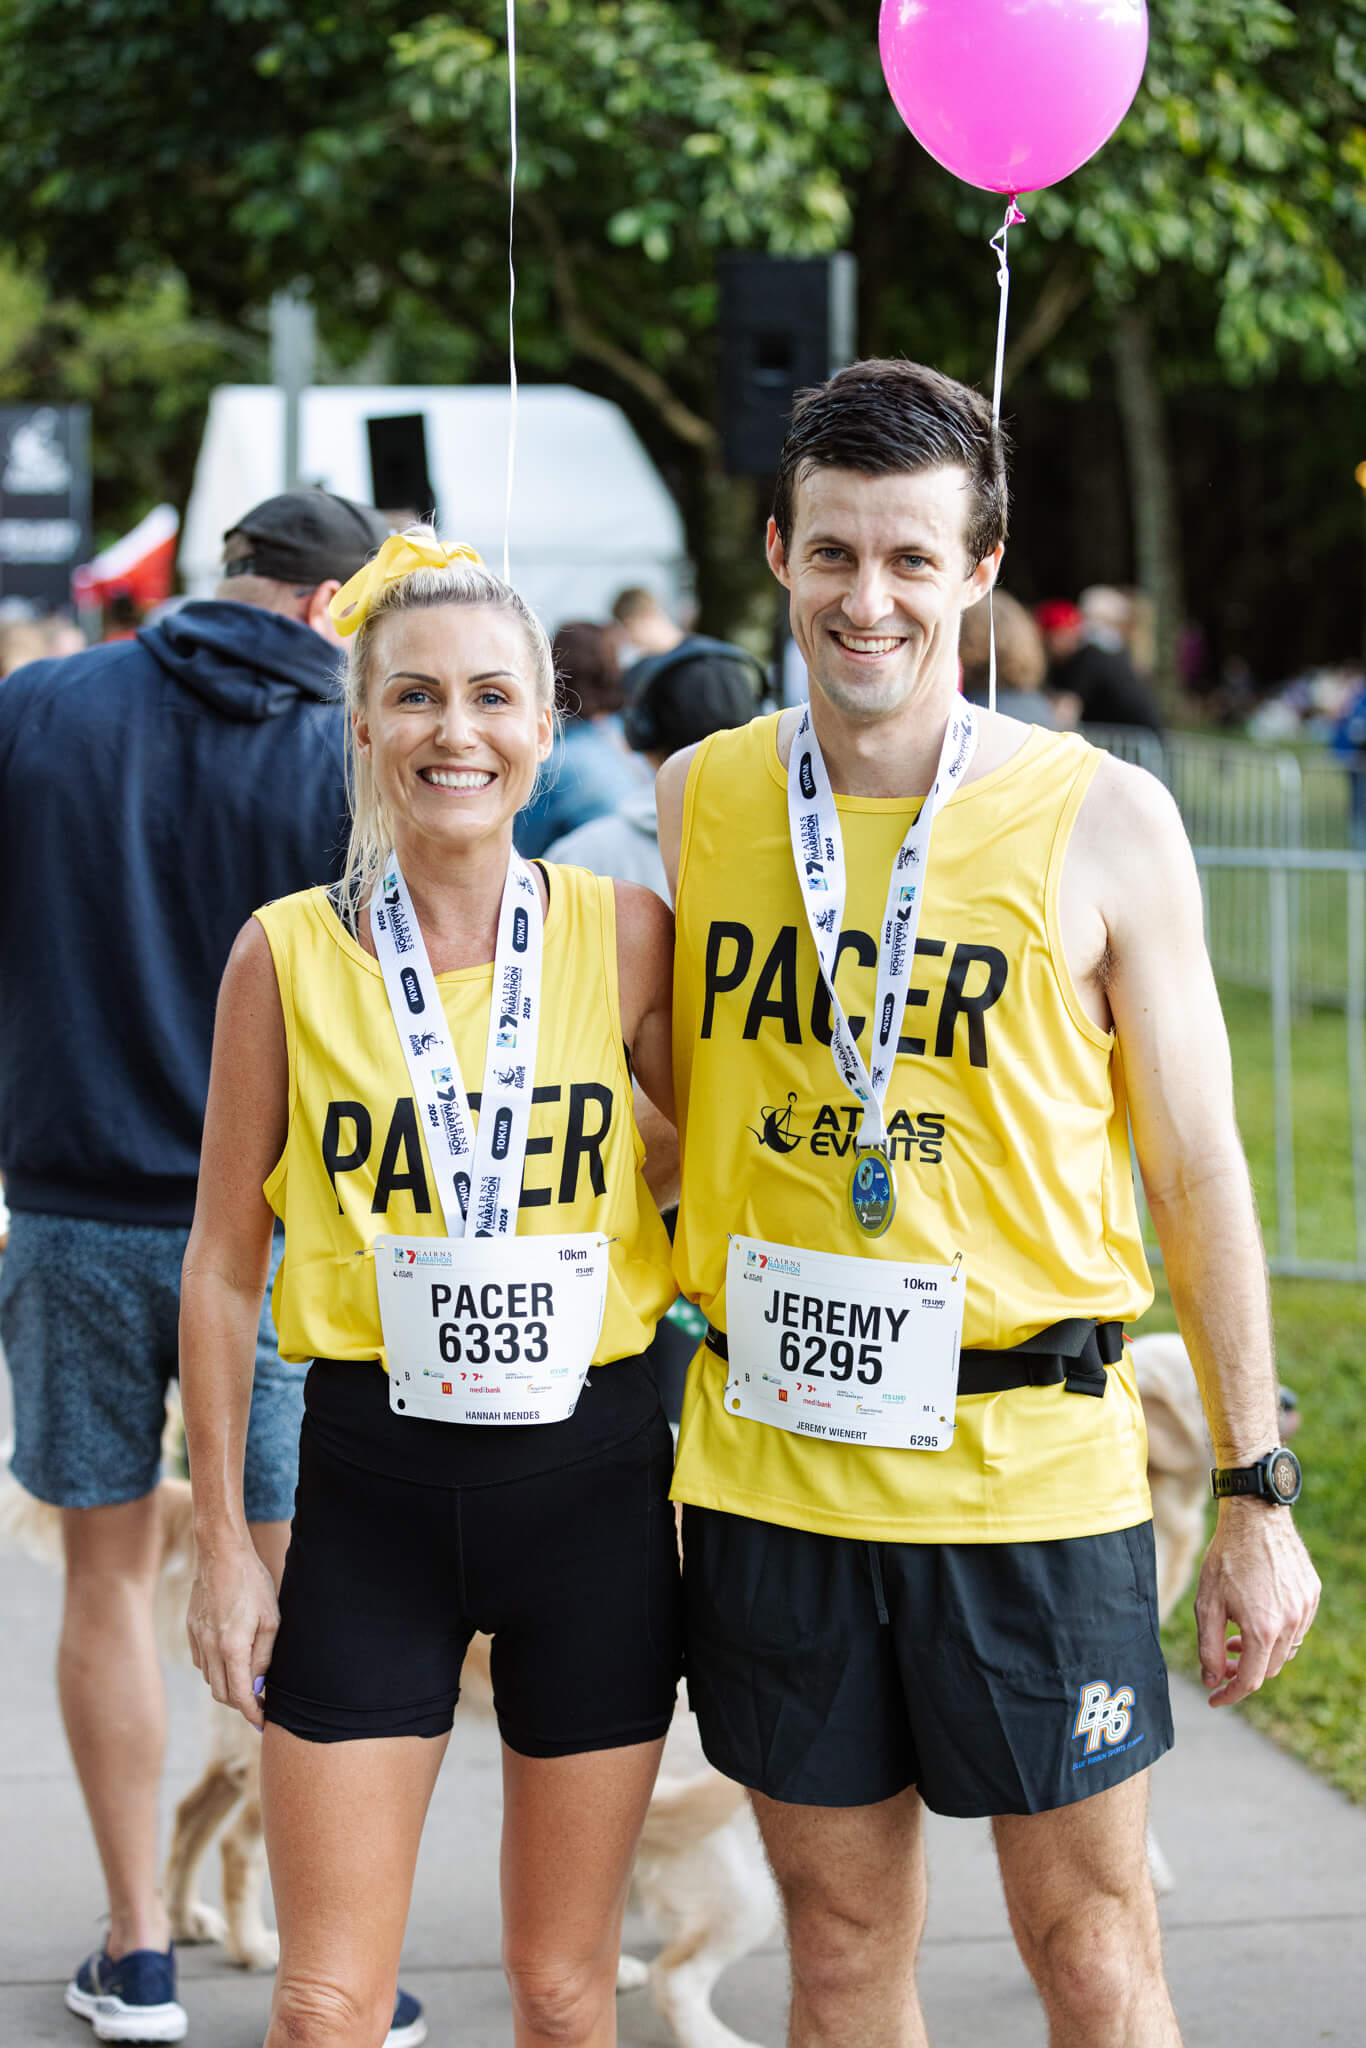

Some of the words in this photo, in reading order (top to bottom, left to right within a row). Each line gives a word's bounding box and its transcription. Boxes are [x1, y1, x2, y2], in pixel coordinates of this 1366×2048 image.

[802, 764, 811, 791] 10KM
[800, 816, 811, 860] CAIRNS
[807, 814, 819, 861] MARATHON
[825, 837, 835, 861] 2024
[376, 910, 386, 931] 2024
[388, 905, 408, 953] MARATHON
[398, 903, 415, 951] CAIRNS
[517, 917, 528, 945] 10KM
[885, 920, 893, 945] 2024
[891, 921, 904, 977] MARATHON
[404, 974, 419, 1004] 10KM
[501, 965, 511, 1014] CAIRNS
[508, 966, 519, 1015] MARATHON
[523, 996, 532, 1020] 2024
[881, 1001, 892, 1034] 10KM
[427, 1103, 440, 1127] 2024
[441, 1103, 462, 1156] MARATHON
[451, 1101, 469, 1154] CAIRNS
[812, 1105, 946, 1139] ATAS
[322, 1082, 613, 1215] PAER
[496, 1120, 509, 1151] 10KM
[810, 1132, 943, 1164] EVNTS
[476, 1176, 489, 1229] CAIRNS
[483, 1176, 498, 1230] MARATHON
[499, 1208, 509, 1233] 2024
[558, 1249, 587, 1261] 10km
[902, 1277, 938, 1291] 10km
[431, 1282, 554, 1320] PACER
[764, 1289, 910, 1343] JEREMY
[439, 1321, 549, 1364] 6333
[780, 1331, 883, 1385] 6295
[404, 1371, 410, 1381] B
[745, 1372, 750, 1382] B
[465, 1410, 501, 1420] HANNAH
[503, 1410, 540, 1420] MENDES
[922, 1404, 930, 1412] M
[796, 1421, 827, 1435] JEREMY
[829, 1427, 868, 1441] WIENERT
[910, 1434, 938, 1447] 6295
